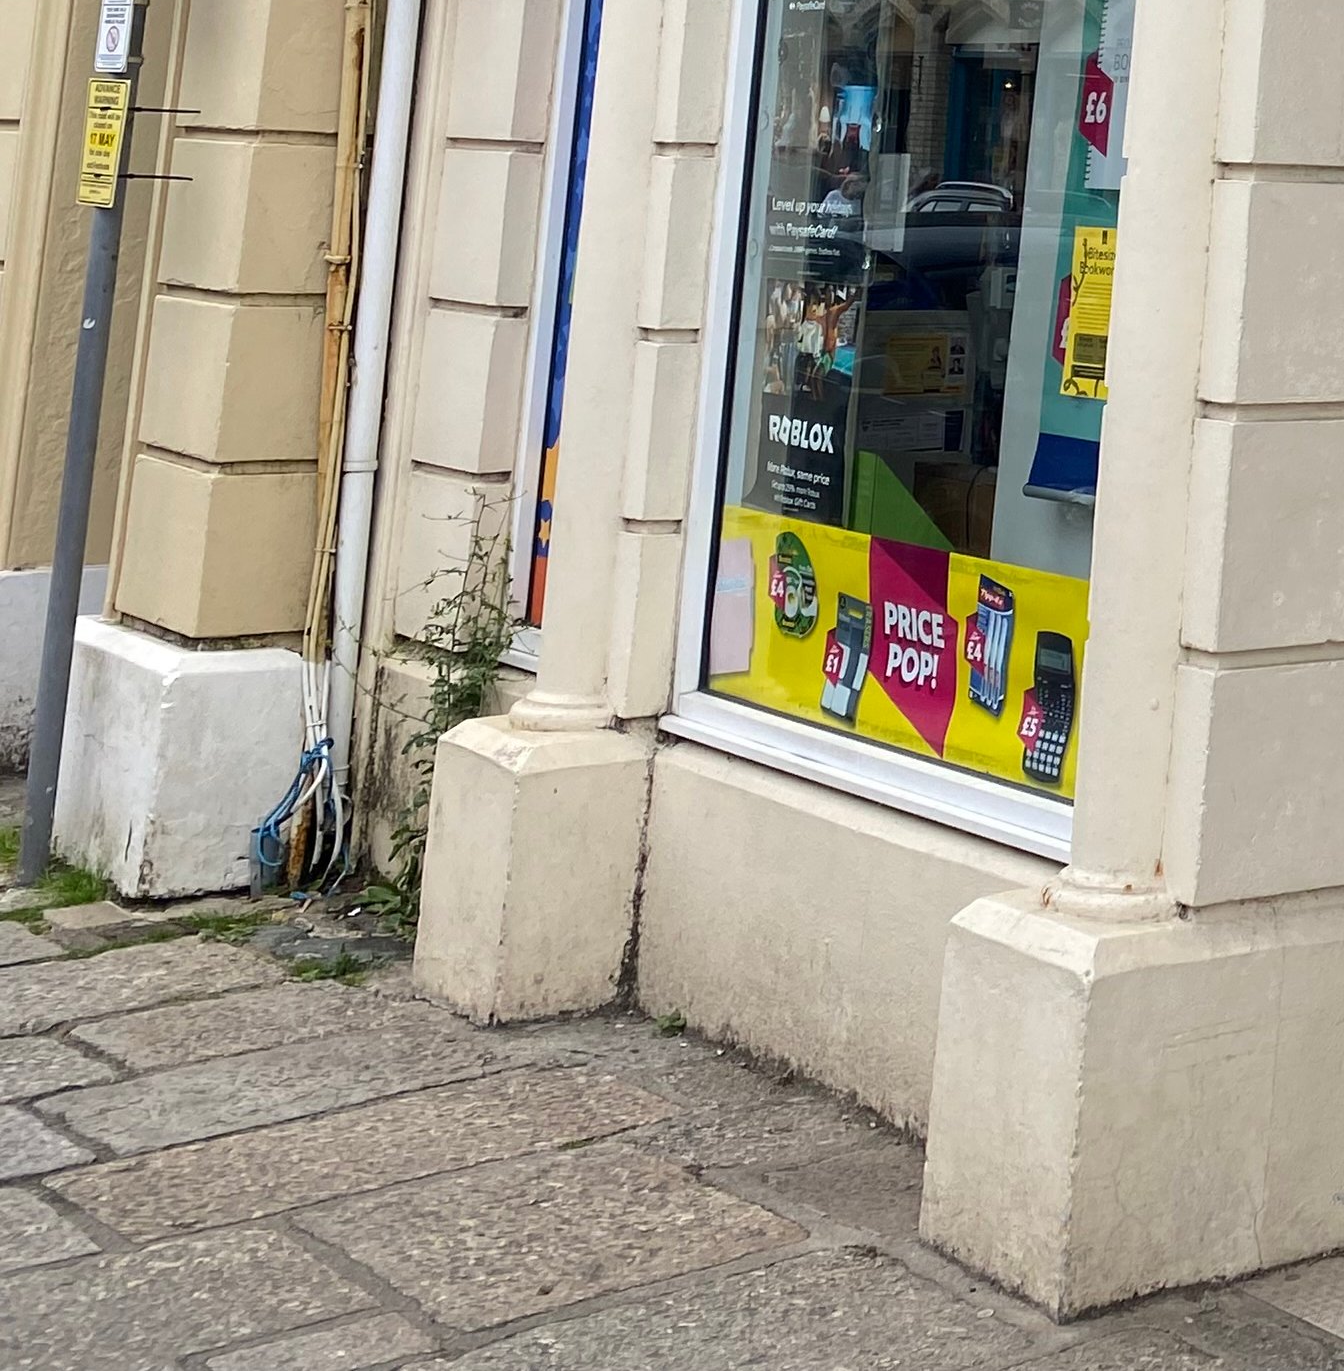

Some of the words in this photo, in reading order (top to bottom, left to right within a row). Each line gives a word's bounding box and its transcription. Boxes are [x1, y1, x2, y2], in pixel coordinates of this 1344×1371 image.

[95, 84, 121, 93] ADVANCE
[94, 95, 119, 105] WARNING
[1085, 91, 1107, 123] £6
[98, 134, 115, 147] MAY
[772, 197, 795, 212] Level
[795, 202, 806, 215] up
[769, 414, 834, 454] ROBLOX
[813, 474, 831, 486] price
[771, 579, 784, 598] £4
[884, 601, 946, 649] PRICE
[967, 641, 982, 662] £4
[826, 654, 838, 674] £1
[886, 642, 940, 690] POP!
[1020, 719, 1037, 738] £5
